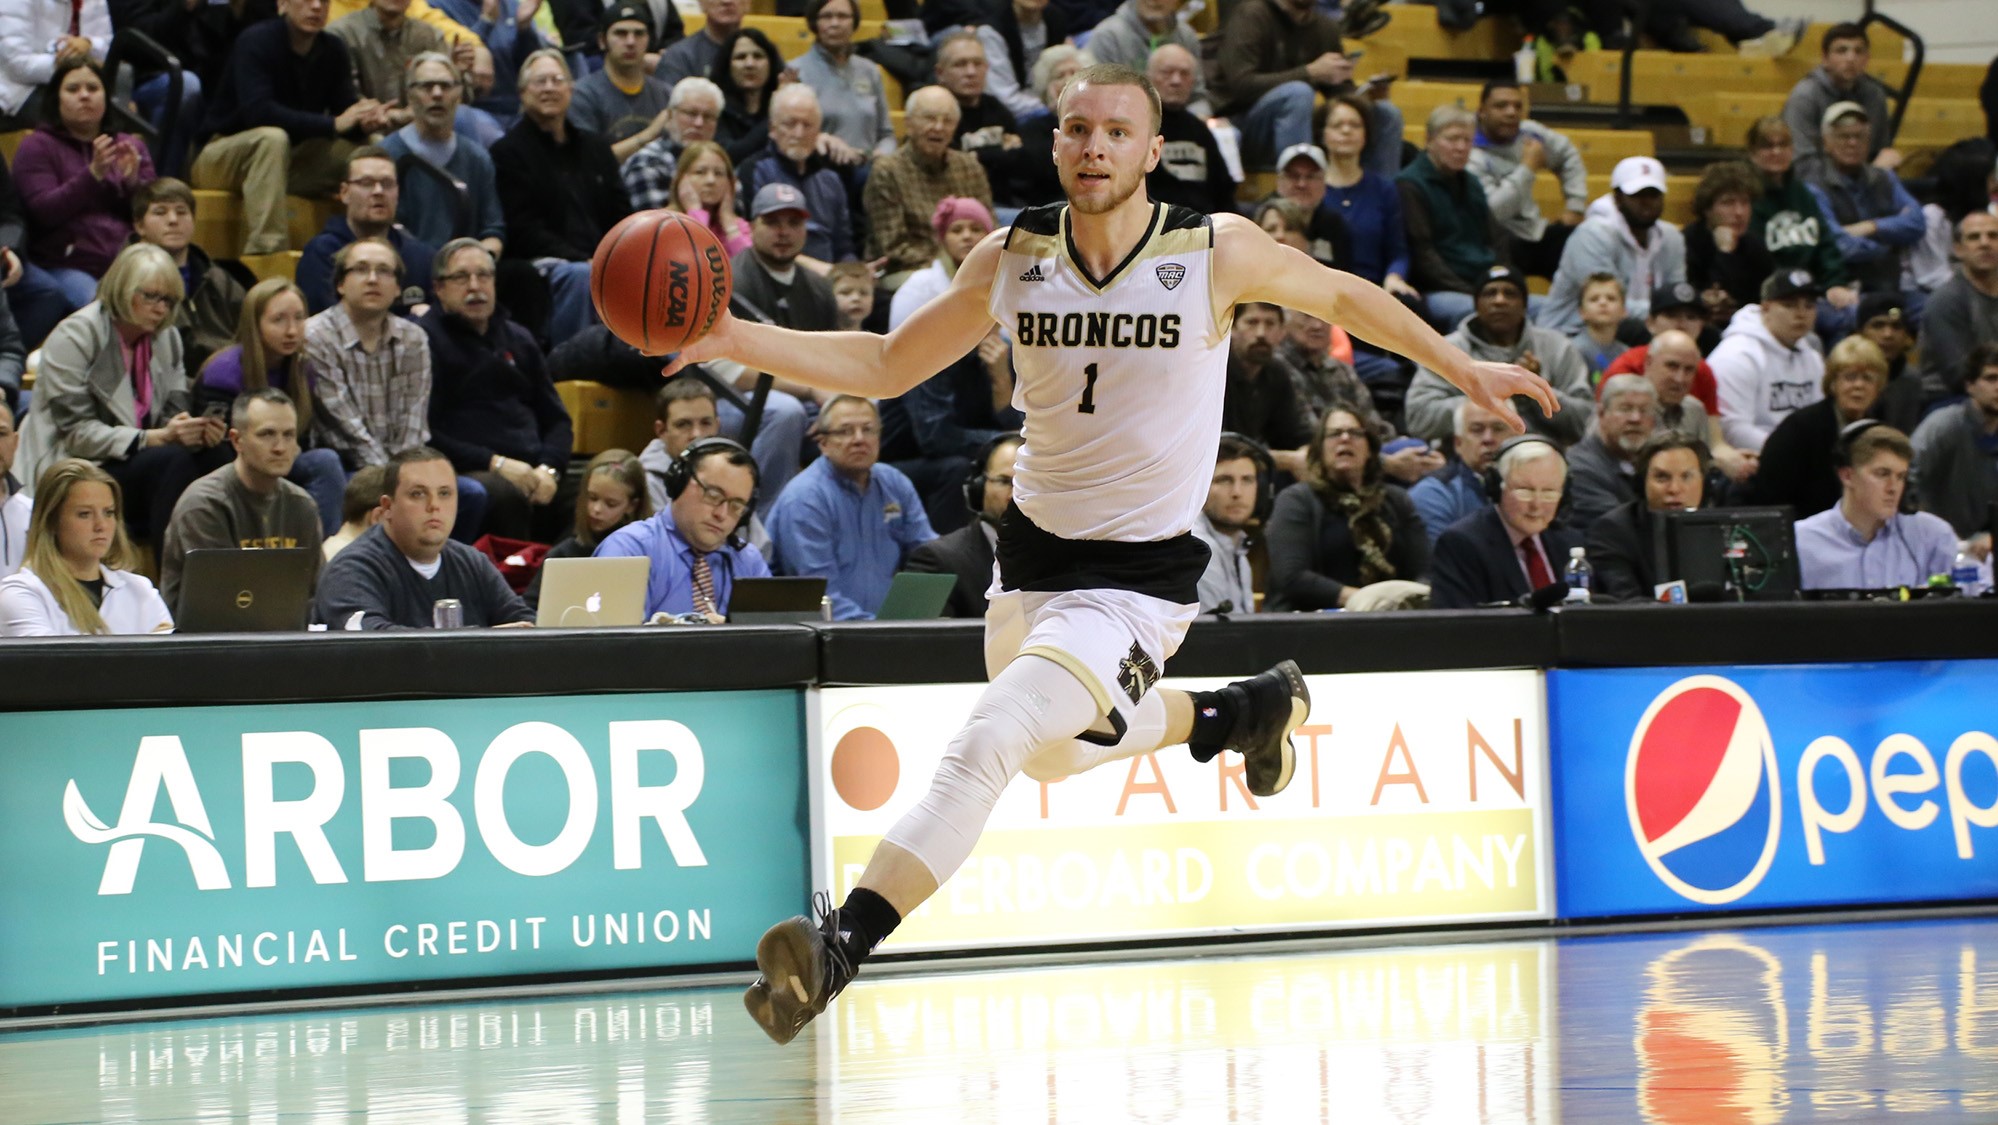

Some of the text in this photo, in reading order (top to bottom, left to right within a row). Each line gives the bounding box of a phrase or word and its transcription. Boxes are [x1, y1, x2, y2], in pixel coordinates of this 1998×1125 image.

[664, 260, 689, 328] NCAA
[1017, 311, 1181, 348] BRONCOS
[1078, 363, 1098, 414] 1
[1039, 717, 1527, 819] ARTAN
[1797, 730, 1998, 866] pep
[62, 719, 709, 896] ARBOR
[843, 833, 1527, 918] PERBOARD COMPANY
[98, 908, 713, 976] FINANCIAL CREDIT UNION
